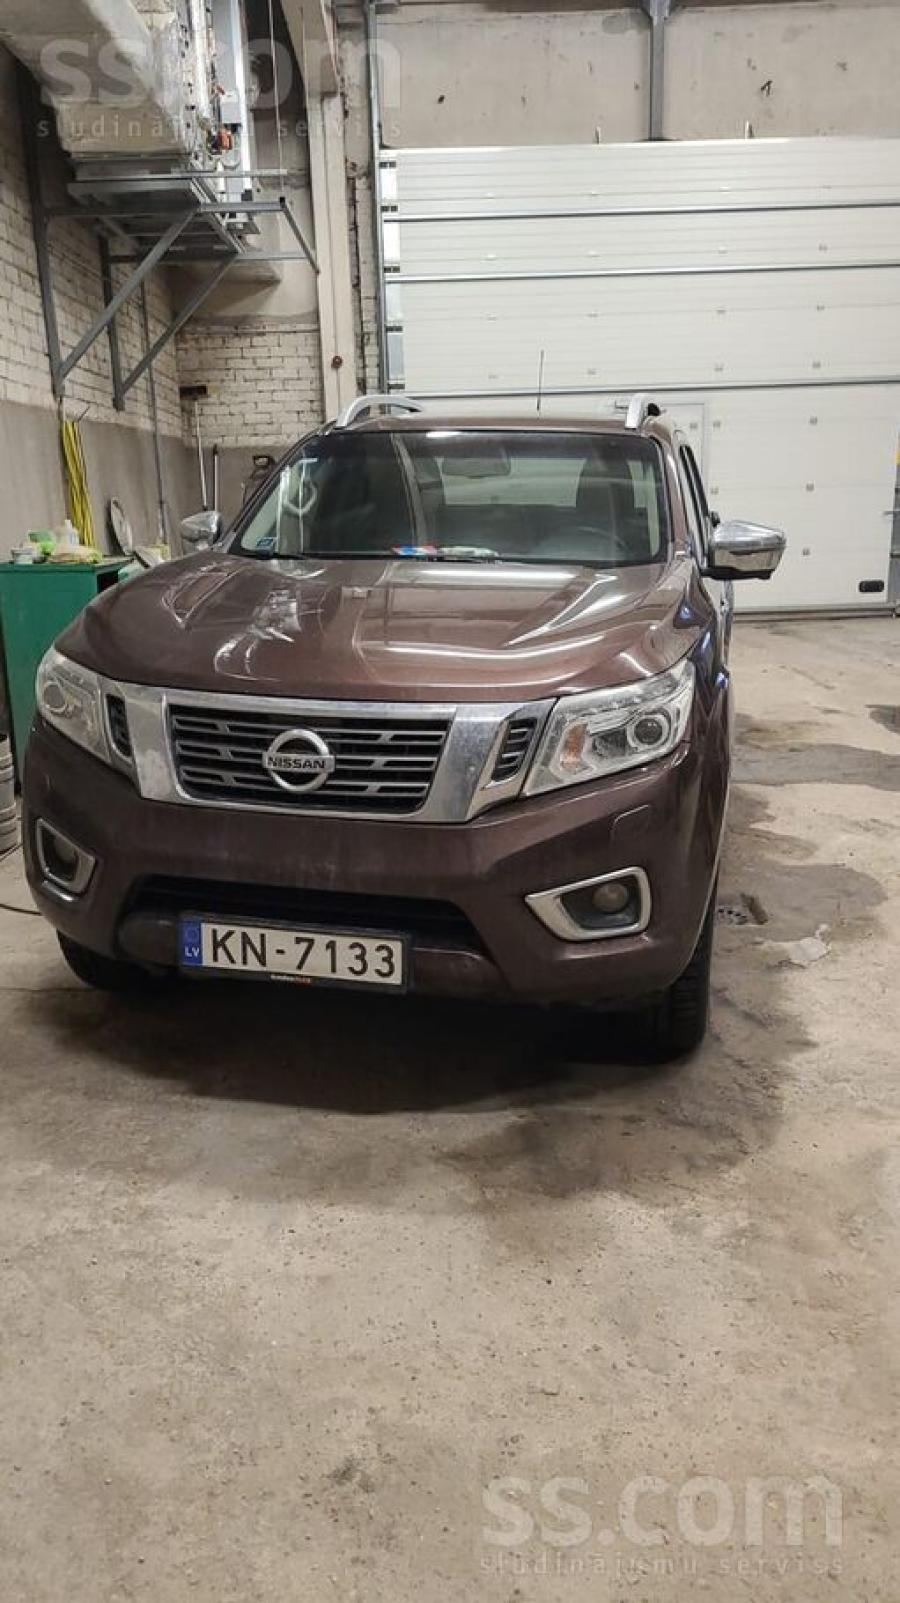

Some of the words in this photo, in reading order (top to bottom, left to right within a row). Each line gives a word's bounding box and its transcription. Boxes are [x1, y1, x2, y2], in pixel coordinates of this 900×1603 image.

[266, 755, 326, 769] NISSAN
[185, 946, 200, 958] LV
[211, 928, 395, 978] KN-7133
